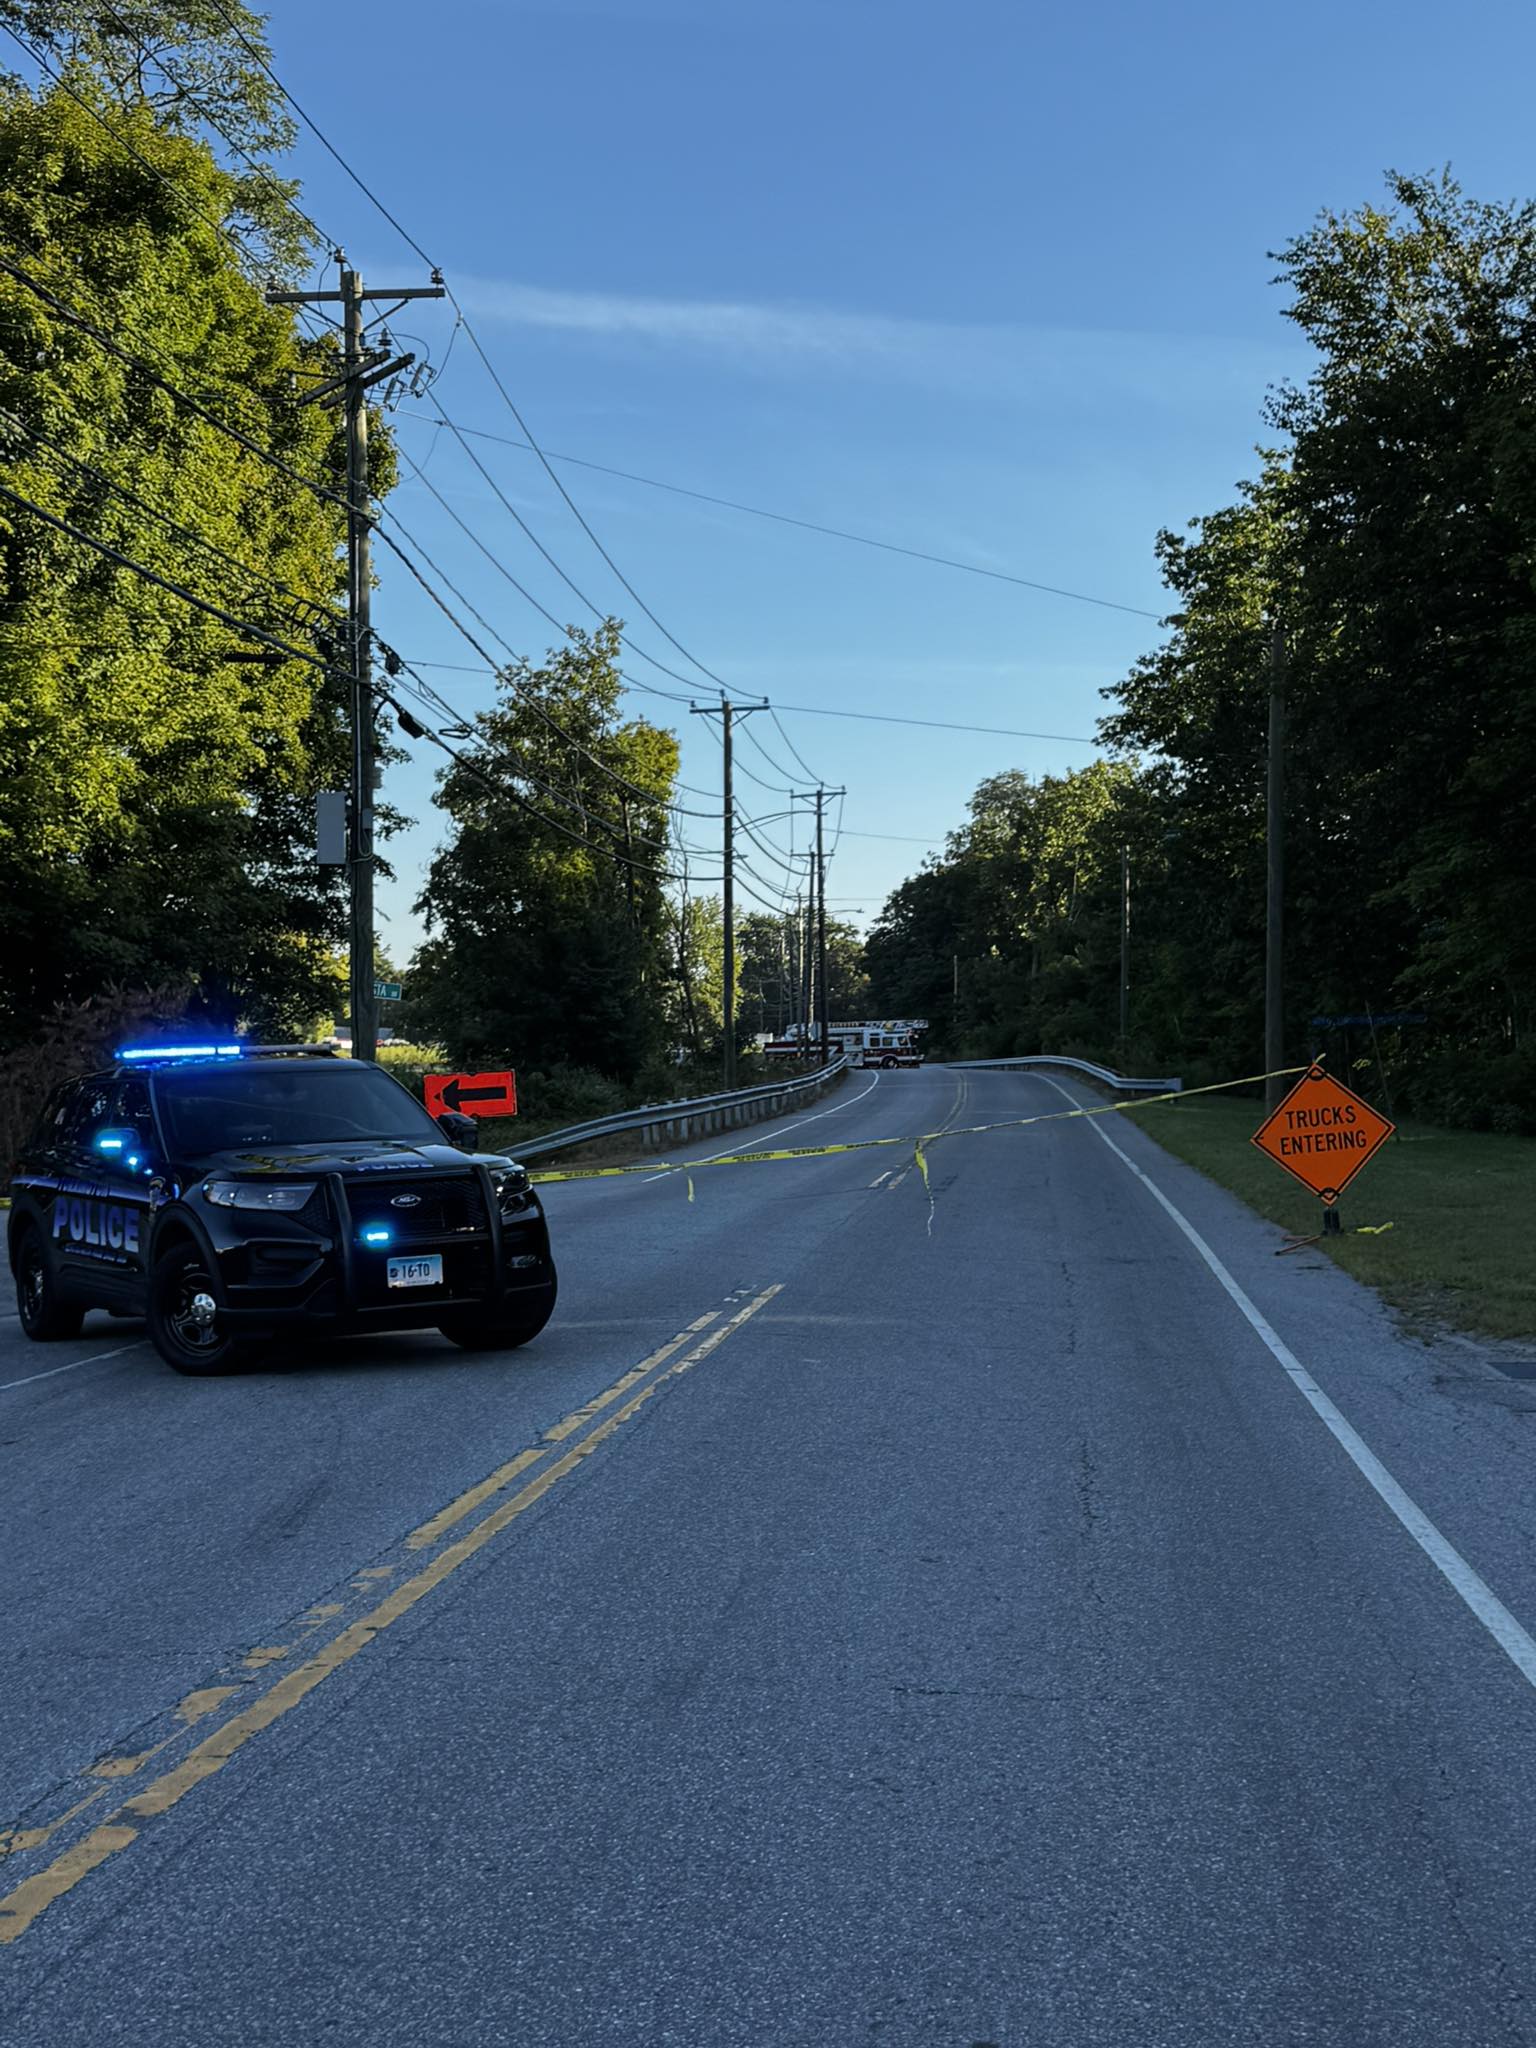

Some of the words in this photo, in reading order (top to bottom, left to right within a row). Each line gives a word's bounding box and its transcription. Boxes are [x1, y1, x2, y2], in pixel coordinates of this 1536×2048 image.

[1285, 1105, 1356, 1129] TRUCKS
[1280, 1130, 1367, 1155] ENTERING
[52, 1196, 140, 1254] POLICE
